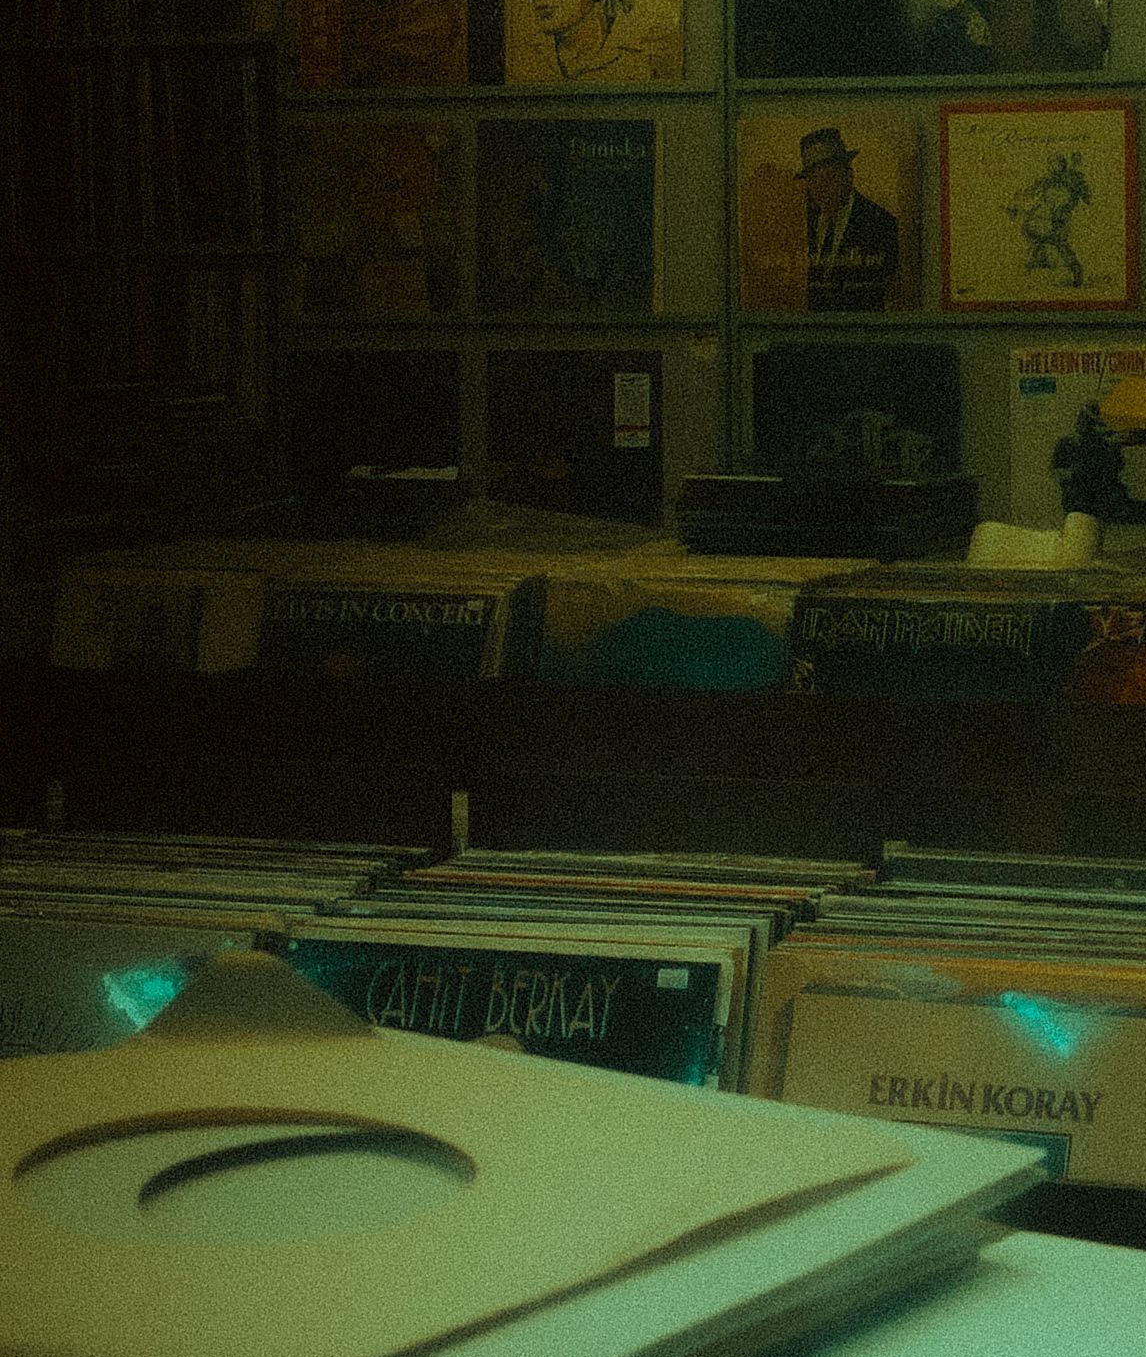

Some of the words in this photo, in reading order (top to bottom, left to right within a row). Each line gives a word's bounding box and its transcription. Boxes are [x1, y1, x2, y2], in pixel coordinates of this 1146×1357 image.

[339, 597, 369, 622] IN
[802, 606, 889, 651] IRON
[893, 608, 1032, 657] MAIDEN
[485, 962, 622, 1039] BERKAY
[869, 1072, 976, 1114] ERKİN
[981, 1083, 1104, 1124] KORAY
